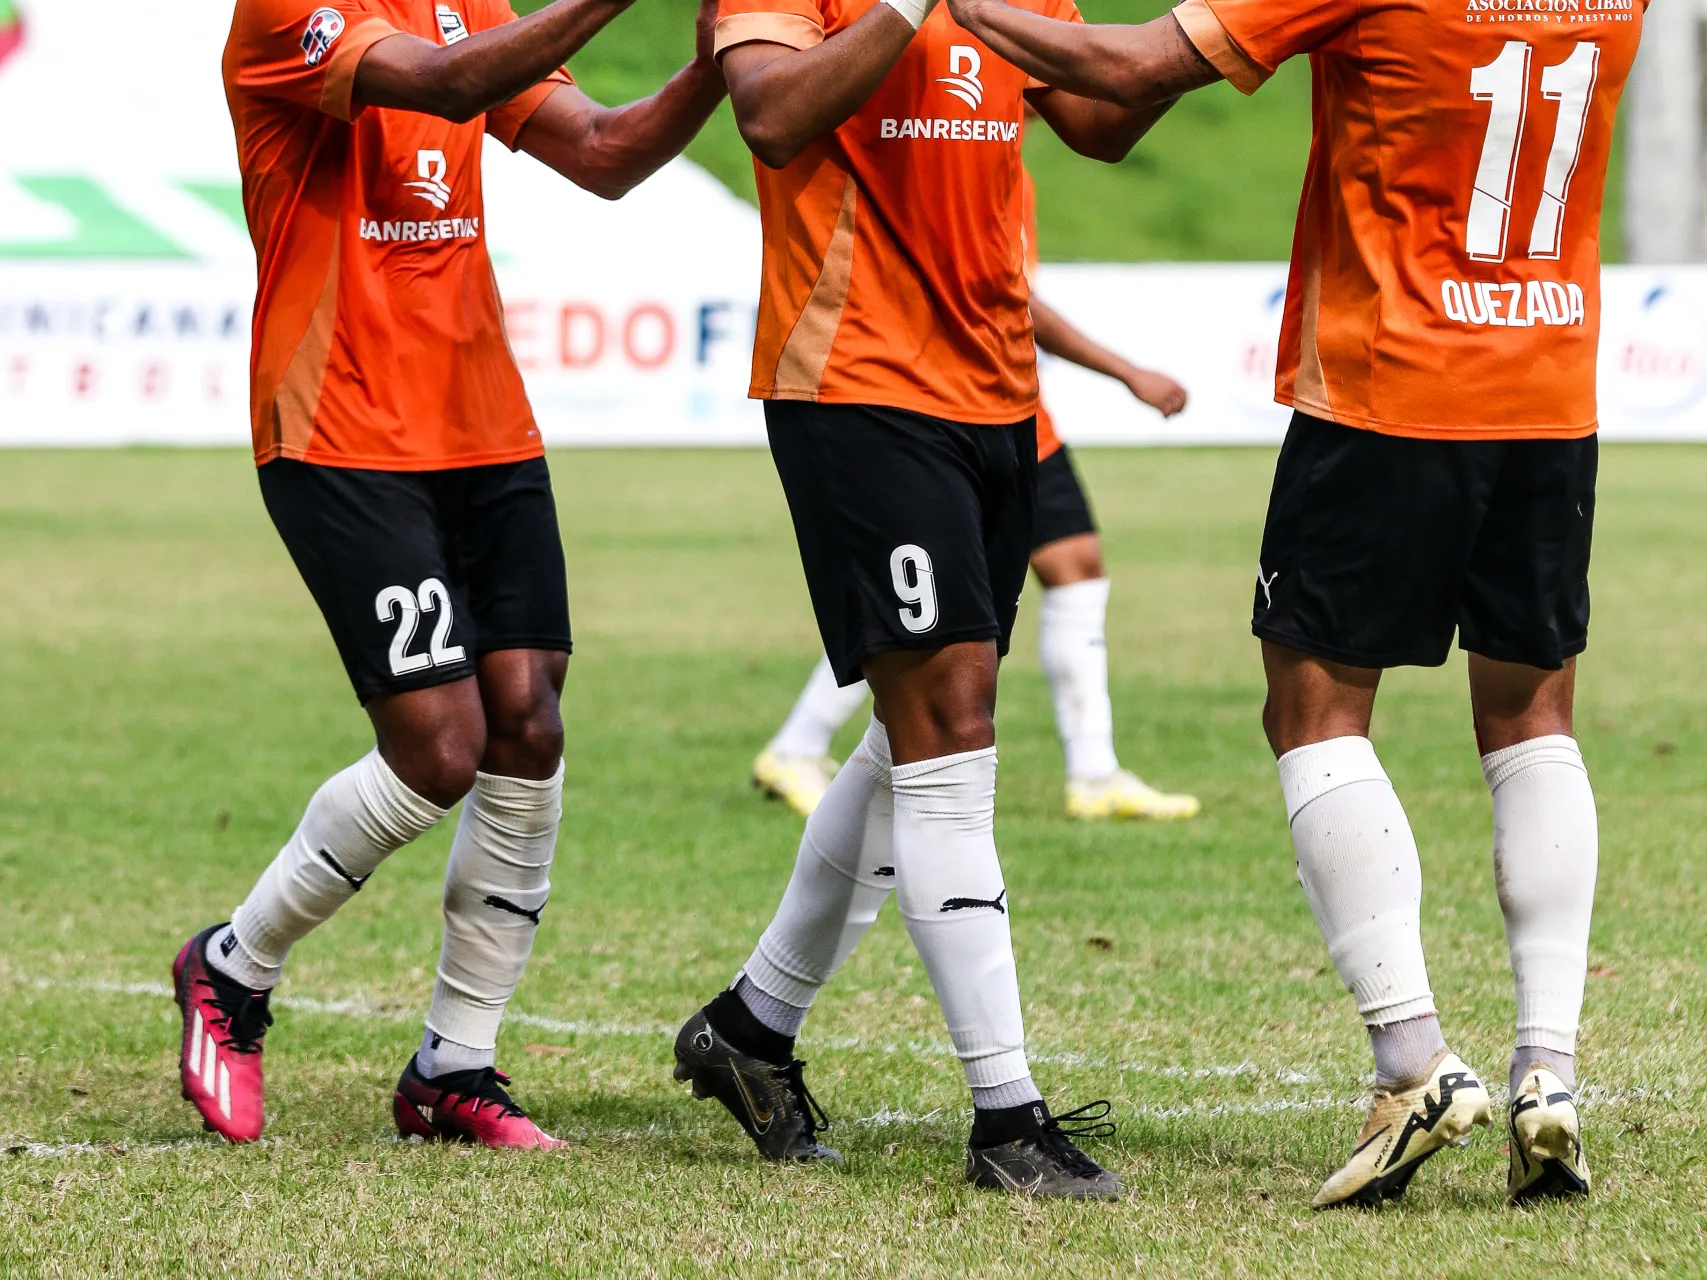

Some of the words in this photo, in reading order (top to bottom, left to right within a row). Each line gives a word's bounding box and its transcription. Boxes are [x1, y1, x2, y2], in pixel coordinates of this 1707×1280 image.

[1466, 14, 1482, 23] DE
[1489, 14, 1549, 23] AHORROS
[1556, 15, 1563, 23] Y
[1570, 13, 1633, 23] PRESTAMOS
[880, 118, 1018, 142] BANRESERVA
[1466, 40, 1600, 262] 11
[503, 300, 759, 371] EDOF
[1441, 279, 1584, 327] QUEZADA
[890, 544, 939, 634] 9
[375, 577, 467, 676] 22
